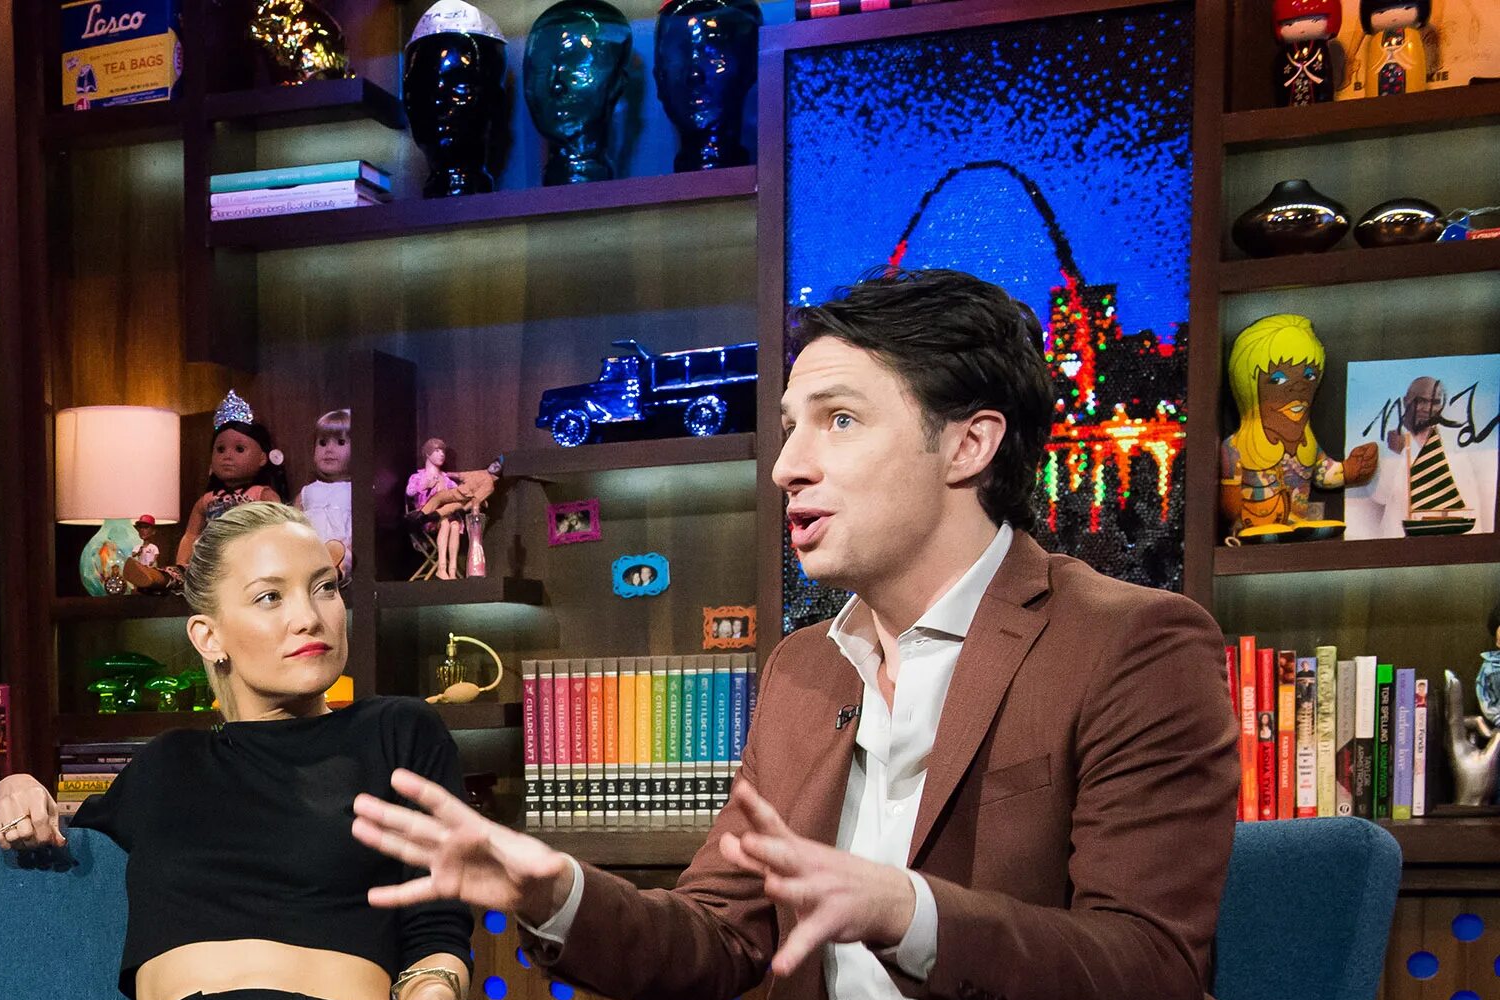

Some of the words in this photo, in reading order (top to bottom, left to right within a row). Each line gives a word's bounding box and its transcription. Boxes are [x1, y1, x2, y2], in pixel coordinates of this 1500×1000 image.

[81, 3, 147, 39] Lasco
[102, 62, 125, 75] TEA
[130, 54, 164, 71] BAGS
[1381, 686, 1390, 705] TORI
[685, 694, 693, 758] CHILDCRAFT
[700, 692, 708, 757] CHILDCRAFT
[733, 692, 742, 756] CHILDCRAFT
[1380, 706, 1389, 743] SPELLING
[1399, 705, 1411, 744] darlene
[83, 780, 110, 790] HABIT
